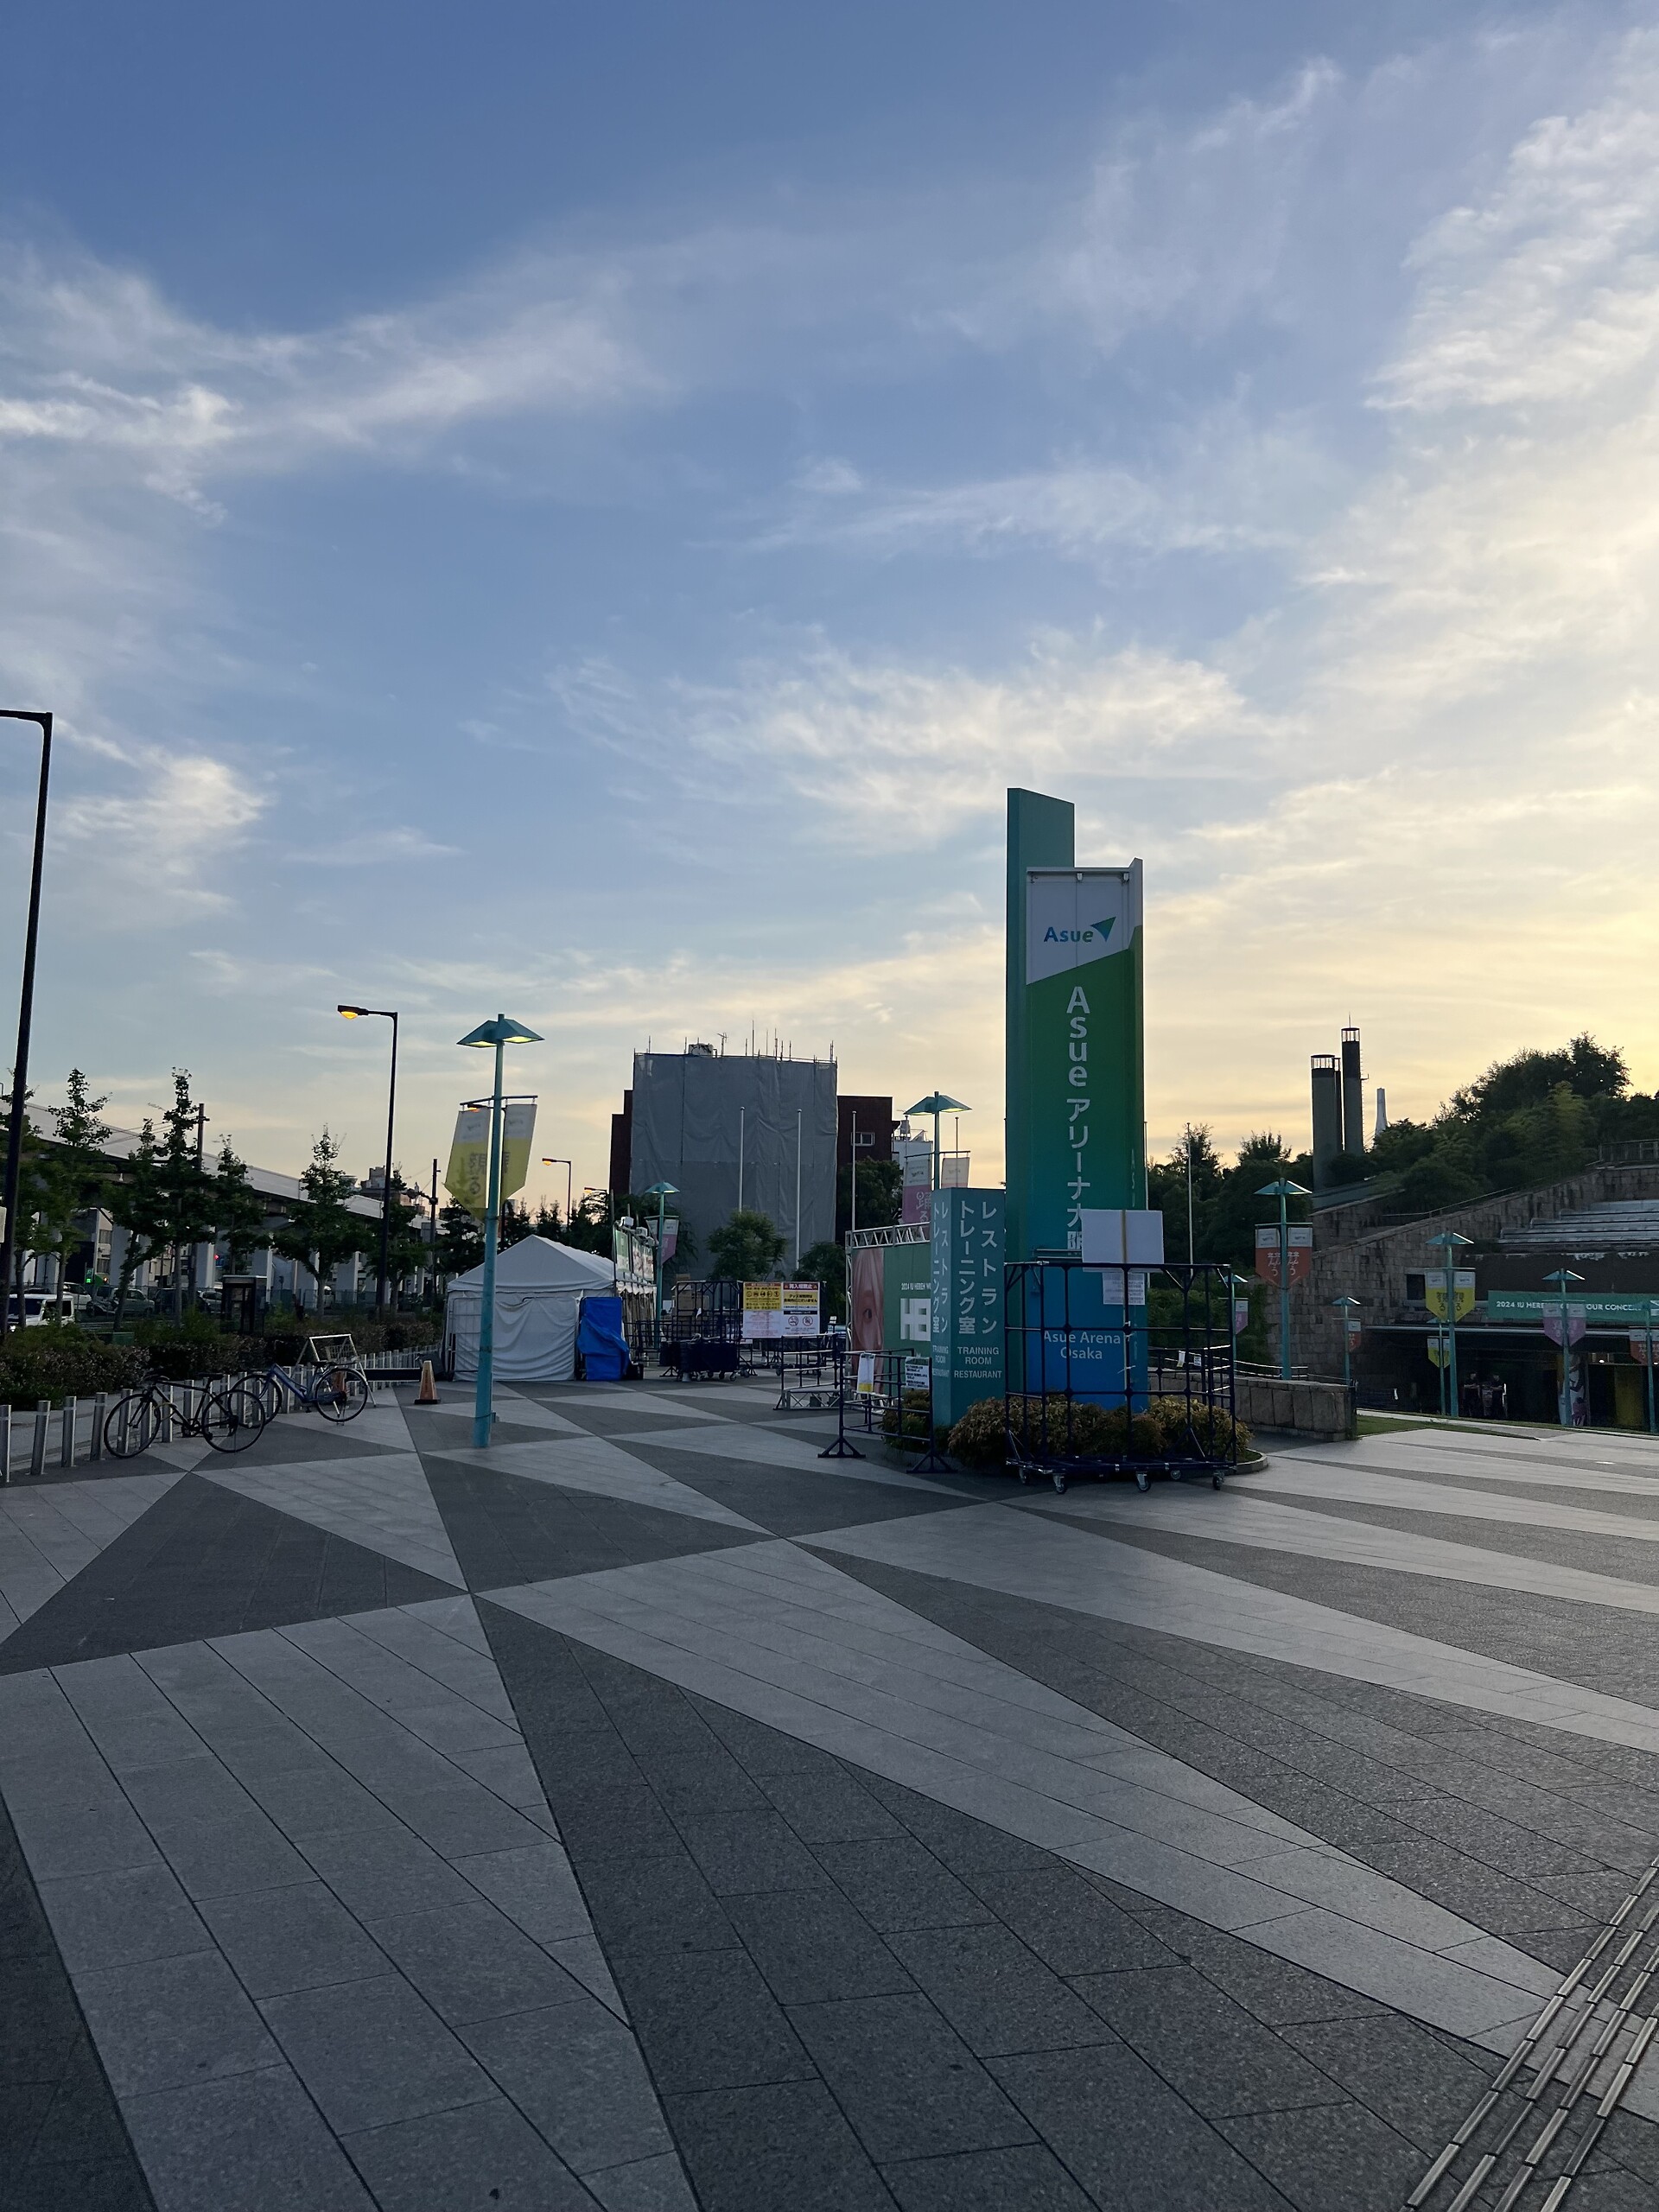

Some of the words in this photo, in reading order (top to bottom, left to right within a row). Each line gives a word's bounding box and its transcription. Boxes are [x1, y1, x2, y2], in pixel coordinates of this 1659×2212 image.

[1044, 926, 1094, 943] Asue
[1066, 986, 1090, 1087] Asue
[958, 1200, 976, 1334] トレーニング室
[982, 1201, 998, 1334] レストラン
[1044, 1331, 1077, 1343] Asue
[1080, 1331, 1121, 1344] Arena
[957, 1346, 1000, 1356] TRAINING
[1060, 1346, 1103, 1360] Osaka
[965, 1357, 992, 1365] ROOM
[954, 1370, 1002, 1379] RESTAURANT
